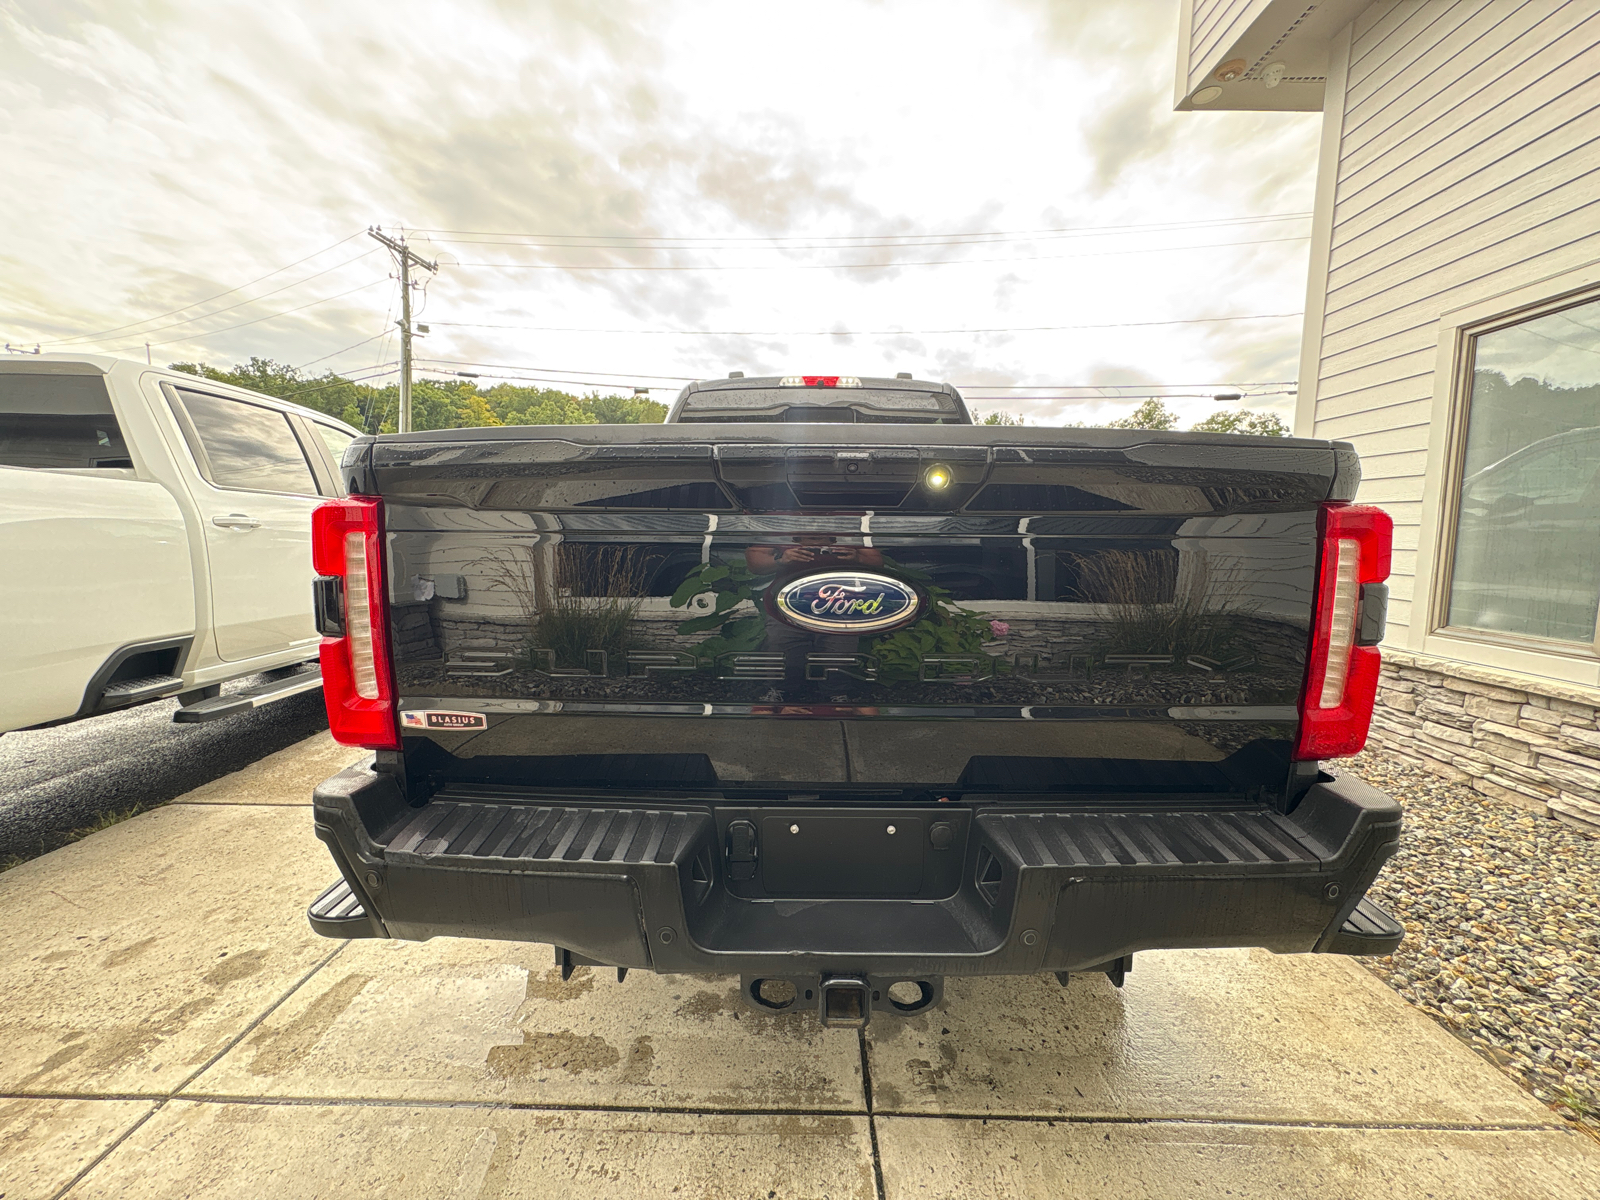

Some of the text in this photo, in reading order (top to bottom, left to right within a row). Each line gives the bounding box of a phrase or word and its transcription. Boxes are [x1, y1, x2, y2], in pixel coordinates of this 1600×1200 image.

[810, 584, 886, 615] Ford
[443, 647, 1258, 683] SUPER DUTY
[431, 715, 475, 724] BLASIUS
